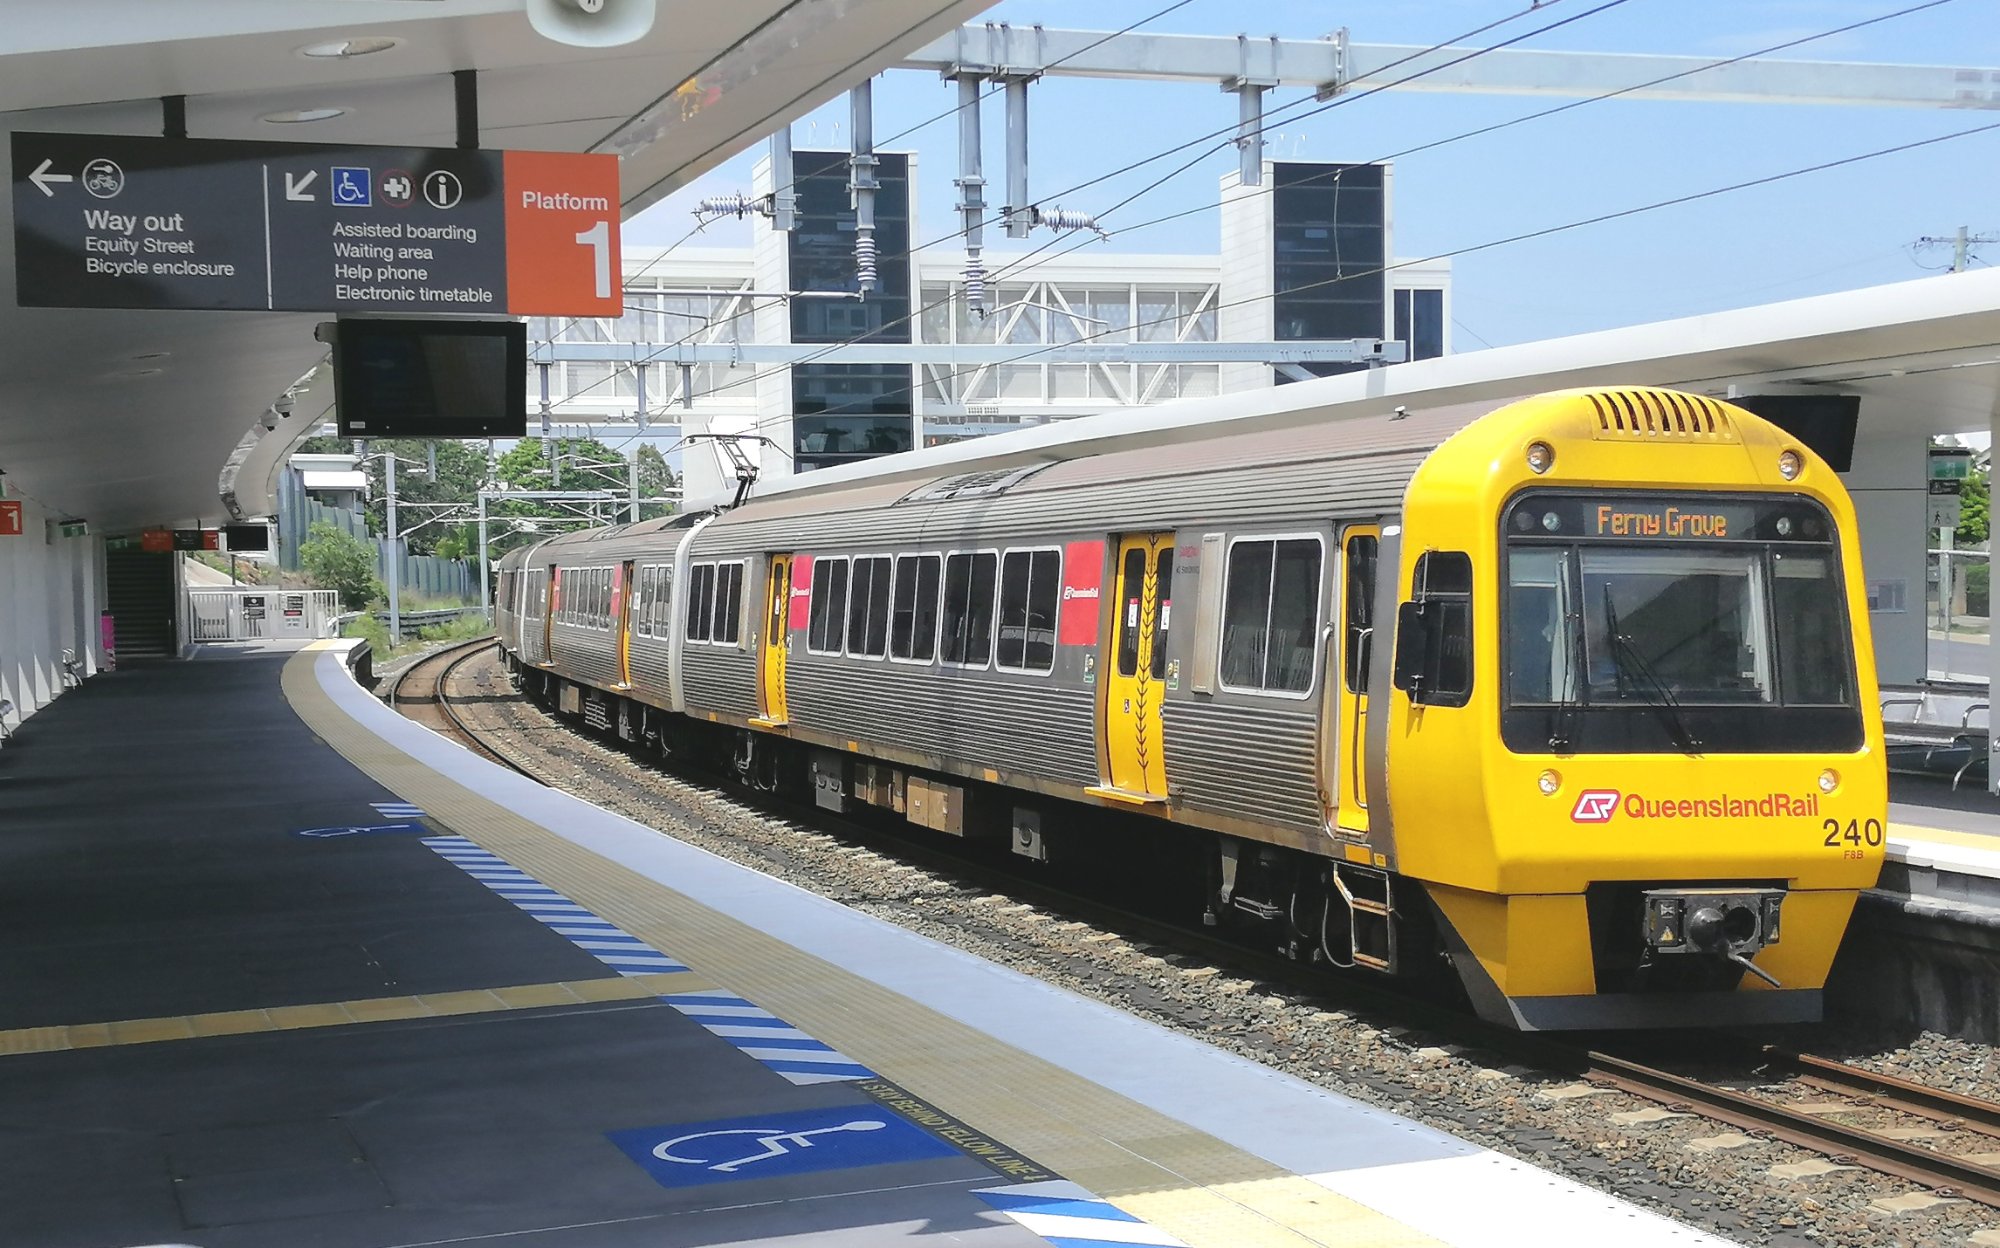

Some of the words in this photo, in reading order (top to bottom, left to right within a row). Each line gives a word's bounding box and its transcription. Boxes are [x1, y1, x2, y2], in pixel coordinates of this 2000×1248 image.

[522, 191, 609, 212] Platform
[84, 209, 137, 236] Way
[143, 213, 184, 232] out
[332, 222, 402, 239] Assisted
[406, 223, 477, 244] boarding
[85, 236, 139, 256] Equity
[143, 237, 195, 254] Street
[333, 242, 394, 262] Waiting
[398, 247, 434, 260] area
[86, 257, 149, 277] Bicycle
[152, 260, 235, 276] enclosure
[575, 221, 612, 299] 1
[334, 263, 373, 282] Help
[377, 265, 428, 282] phone
[335, 284, 416, 301] Electronic
[419, 287, 493, 303] timetable
[8, 510, 18, 531] 1
[1597, 505, 1661, 535] Ferny
[1665, 507, 1727, 537] Grove
[1624, 792, 1819, 819] QueenslandRail
[1823, 818, 1882, 847] 240
[863, 1084, 907, 1099] STAY
[888, 1099, 950, 1126] BEHIND
[934, 1125, 1006, 1155] YELLOW
[985, 1155, 1040, 1175] LINE
